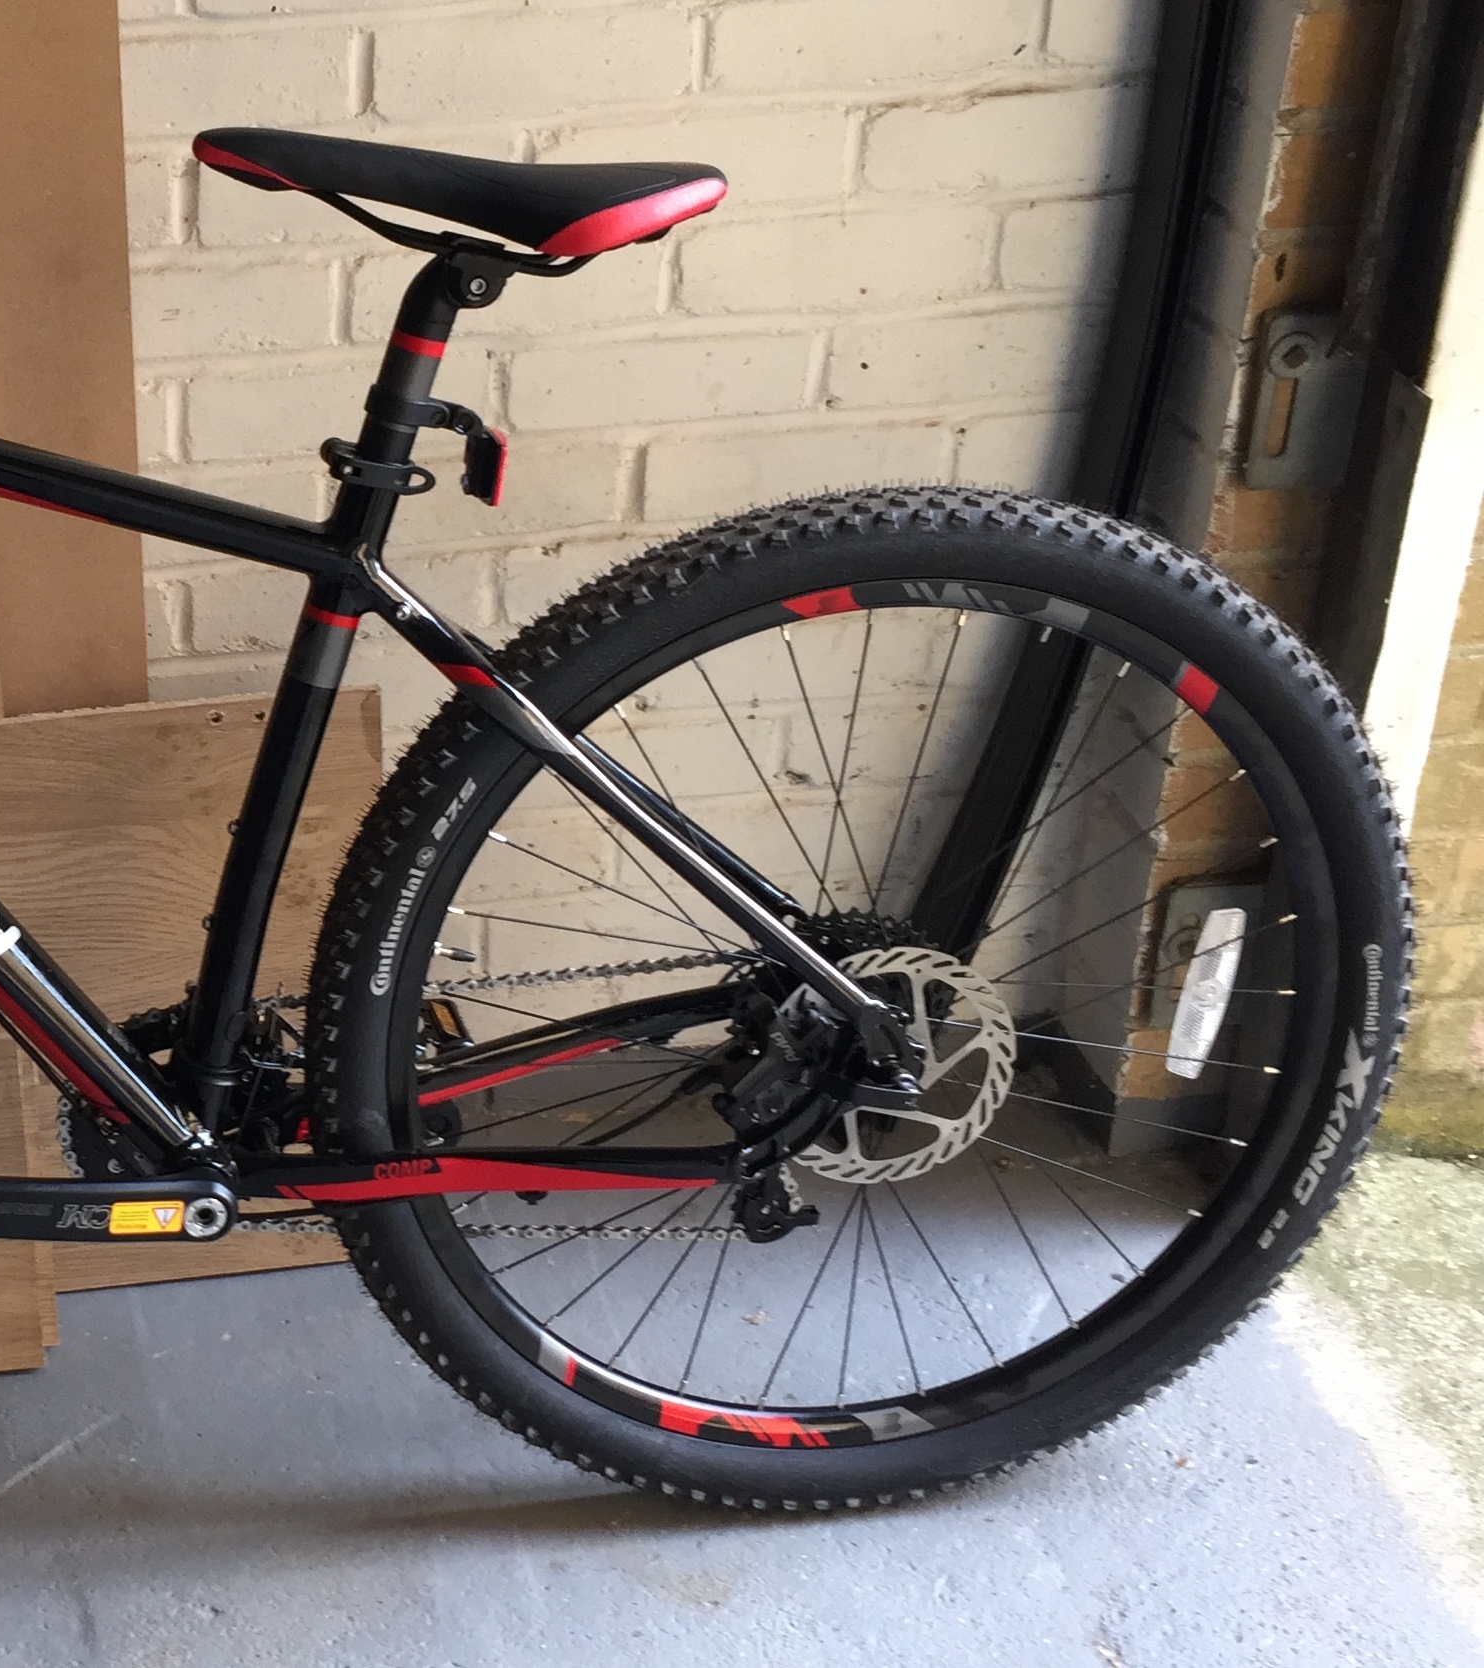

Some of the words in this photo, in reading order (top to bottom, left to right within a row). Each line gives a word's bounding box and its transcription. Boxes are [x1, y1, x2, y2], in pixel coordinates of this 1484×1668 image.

[369, 867, 427, 996] Continental
[431, 777, 478, 841] 27.5
[1362, 943, 1384, 1032] Continental
[373, 1158, 433, 1181] COMP
